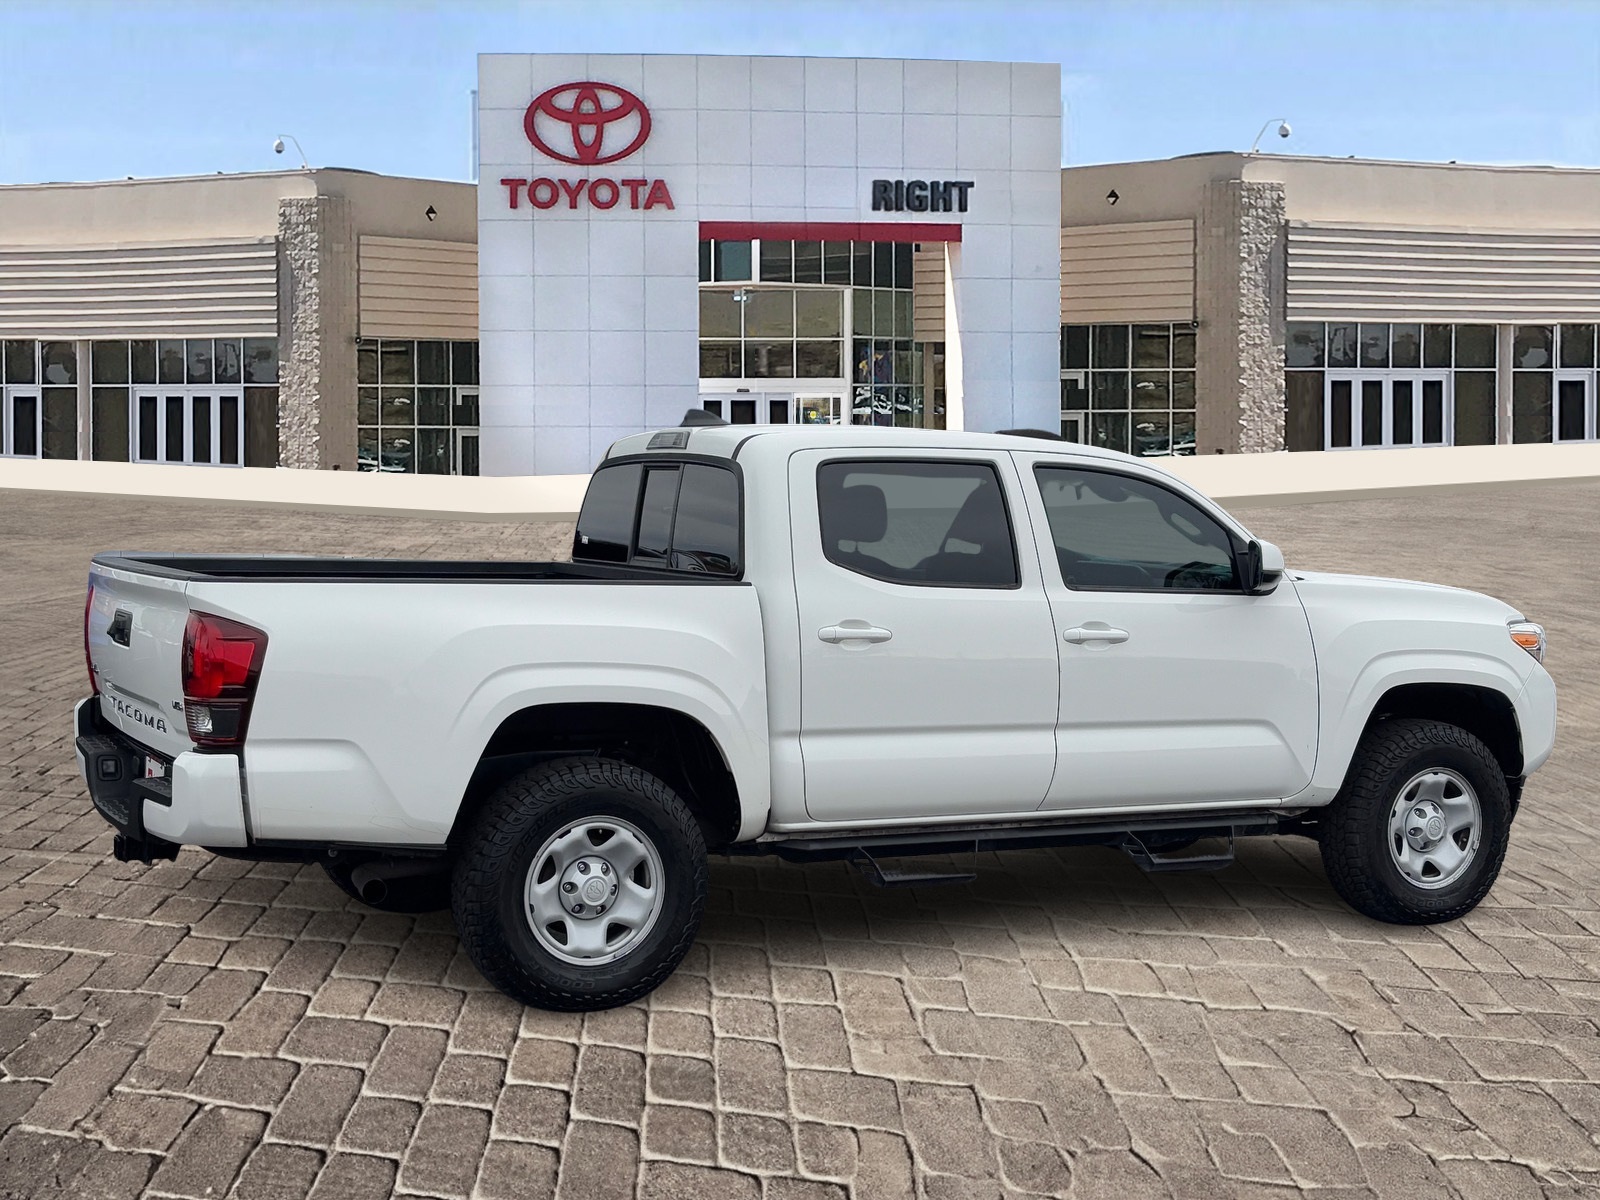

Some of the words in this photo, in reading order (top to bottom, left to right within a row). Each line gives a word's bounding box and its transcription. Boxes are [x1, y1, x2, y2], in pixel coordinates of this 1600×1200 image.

[500, 177, 675, 210] TOYOTA
[872, 179, 974, 212] RIGHT
[110, 695, 167, 734] TACOMA
